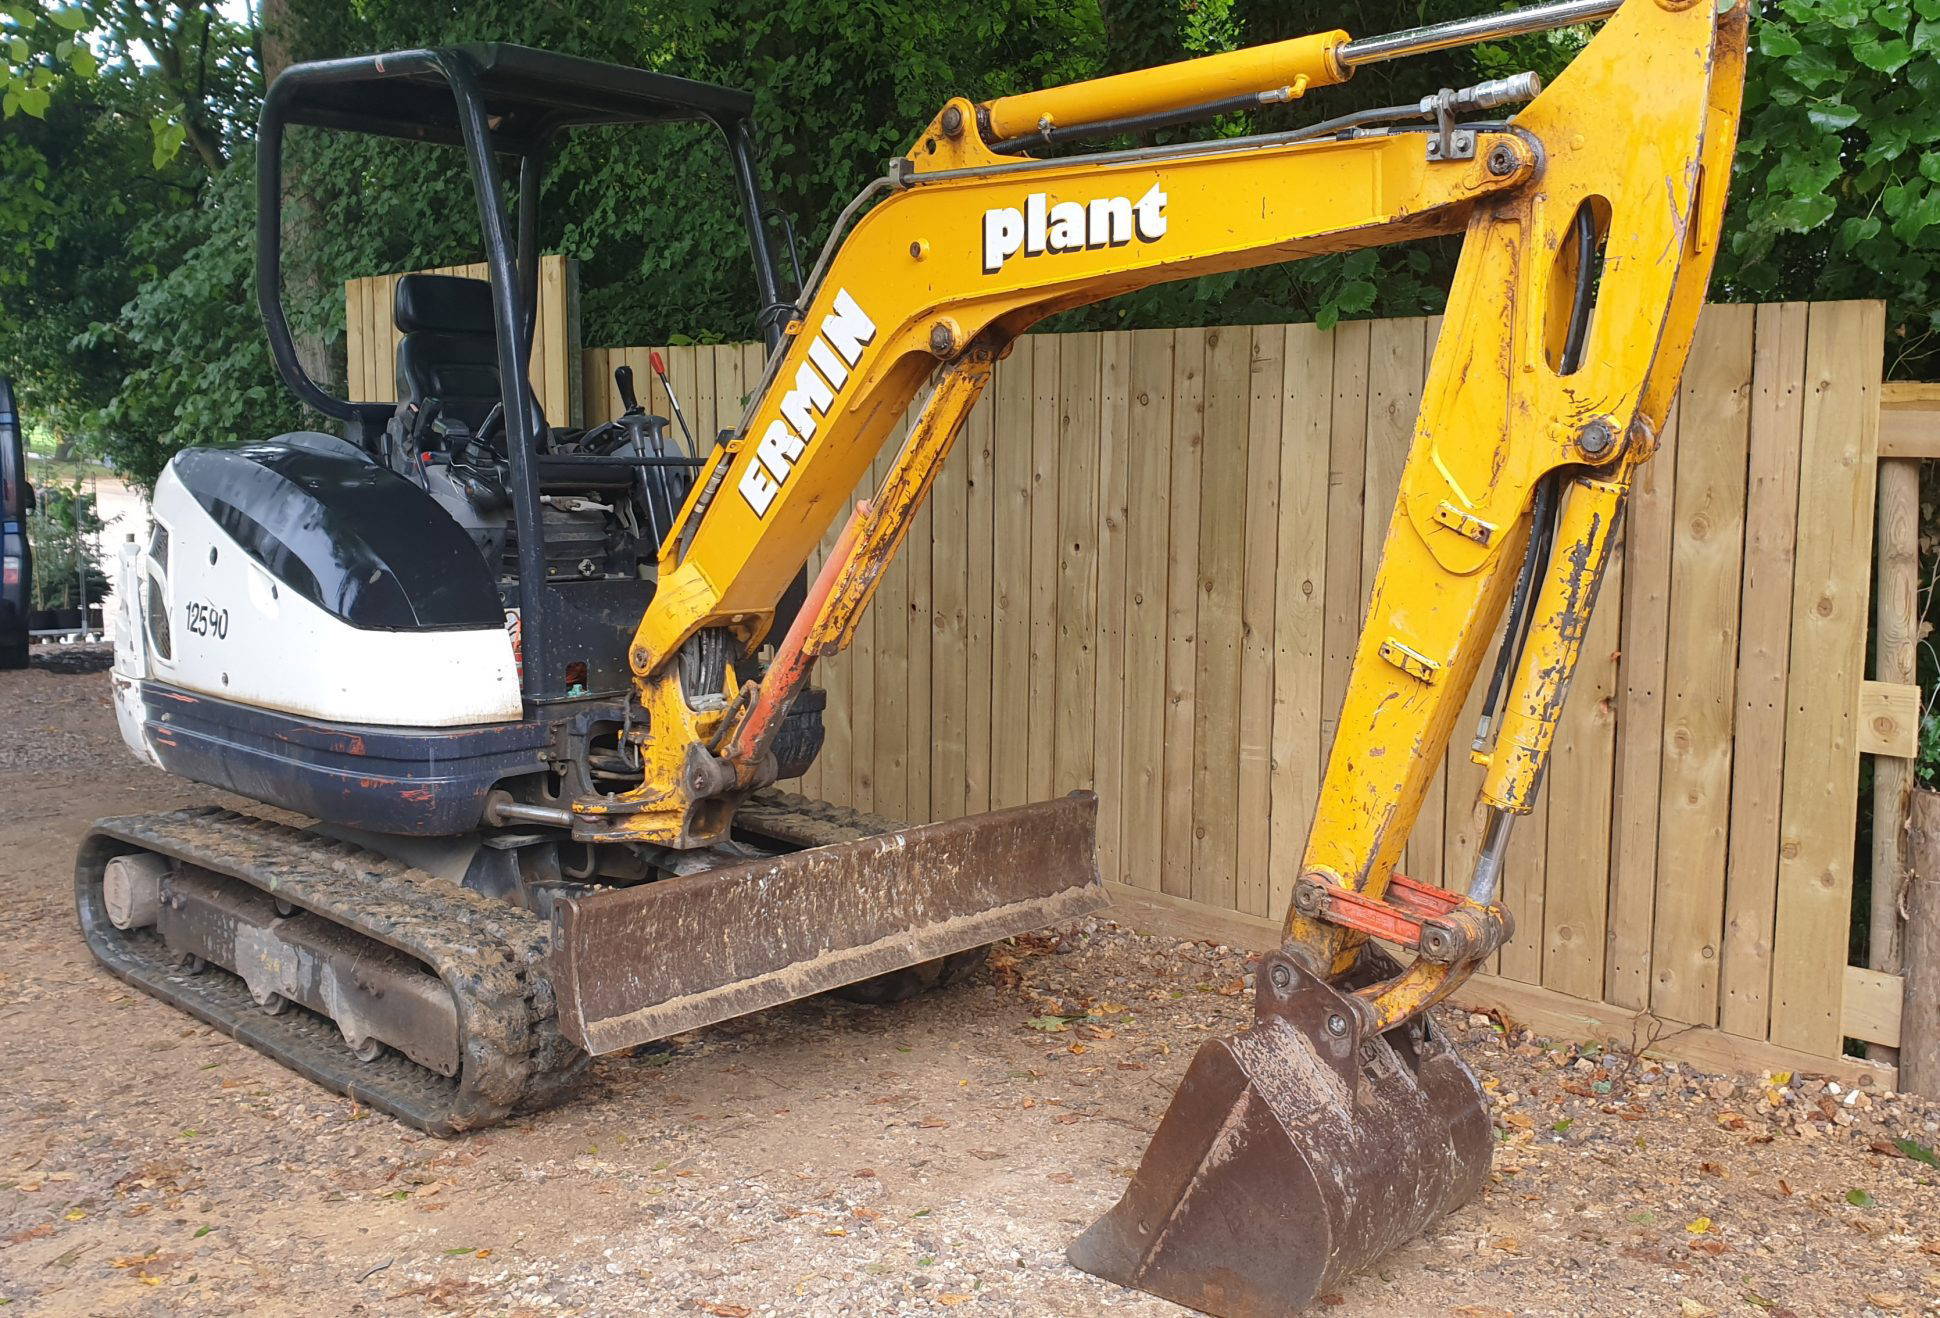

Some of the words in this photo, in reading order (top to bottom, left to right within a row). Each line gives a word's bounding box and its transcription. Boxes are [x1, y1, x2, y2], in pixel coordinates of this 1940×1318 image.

[738, 287, 877, 520] ERMIN
[982, 182, 1167, 275] plant
[186, 601, 228, 640] 12590
